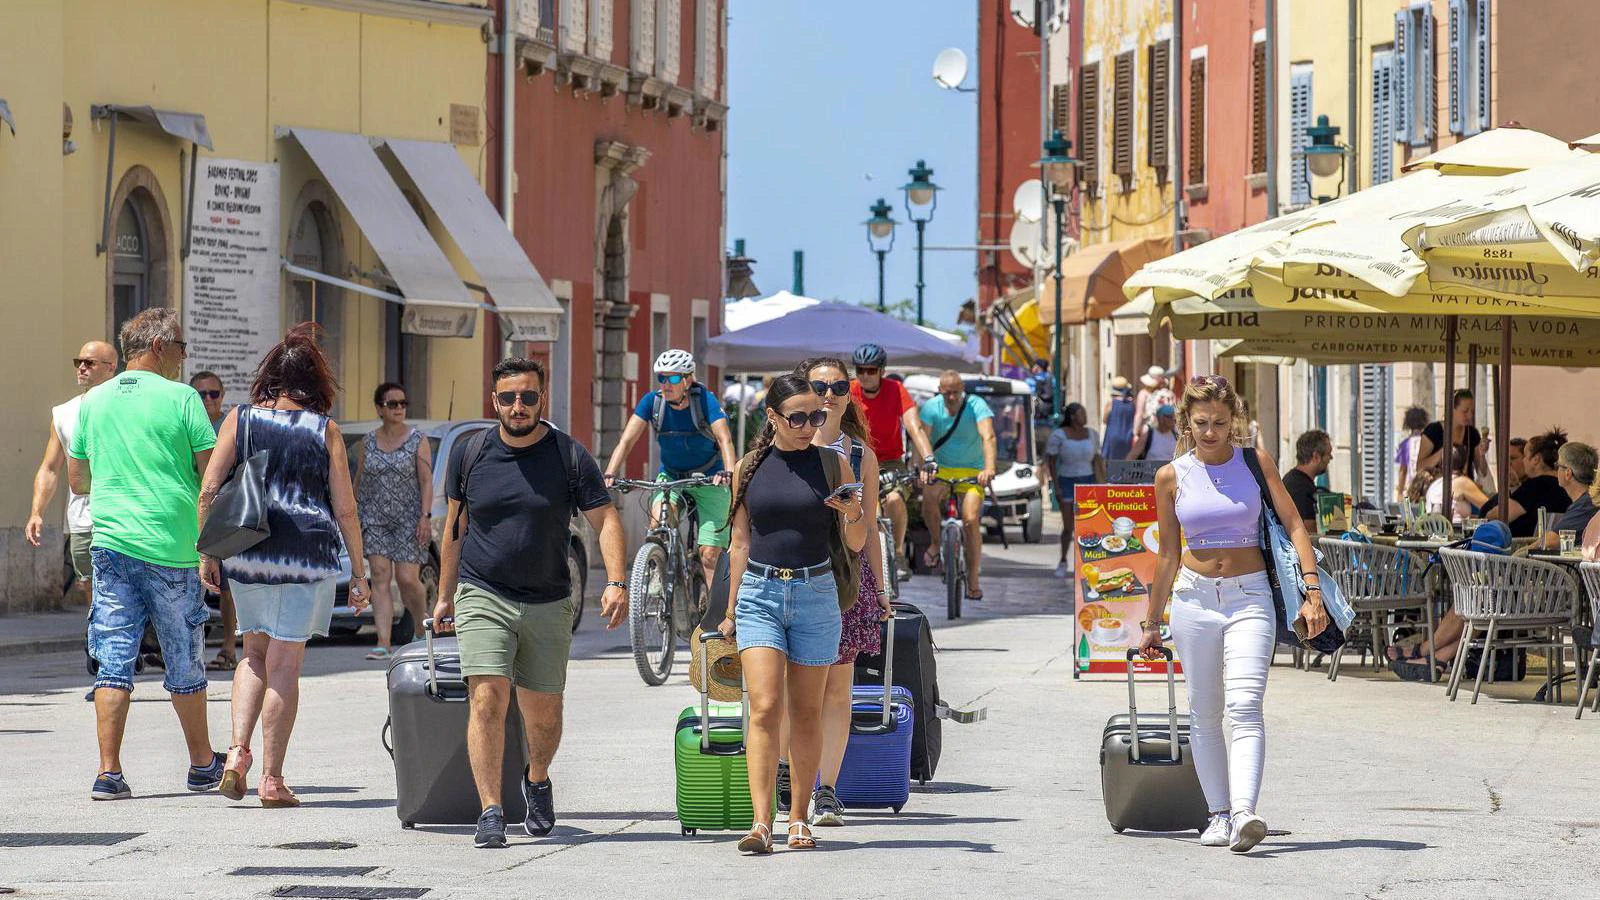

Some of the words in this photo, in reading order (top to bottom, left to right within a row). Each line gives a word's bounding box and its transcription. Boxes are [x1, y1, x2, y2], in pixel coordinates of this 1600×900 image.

[1304, 315, 1400, 329] PRIRODNA
[1410, 316, 1519, 333] MINRALA
[1528, 320, 1580, 336] VODA
[1311, 342, 1398, 353] CARBONATED
[1403, 343, 1461, 354] NATURL
[1530, 347, 1575, 359] WATER
[1107, 502, 1149, 511] Frühstück
